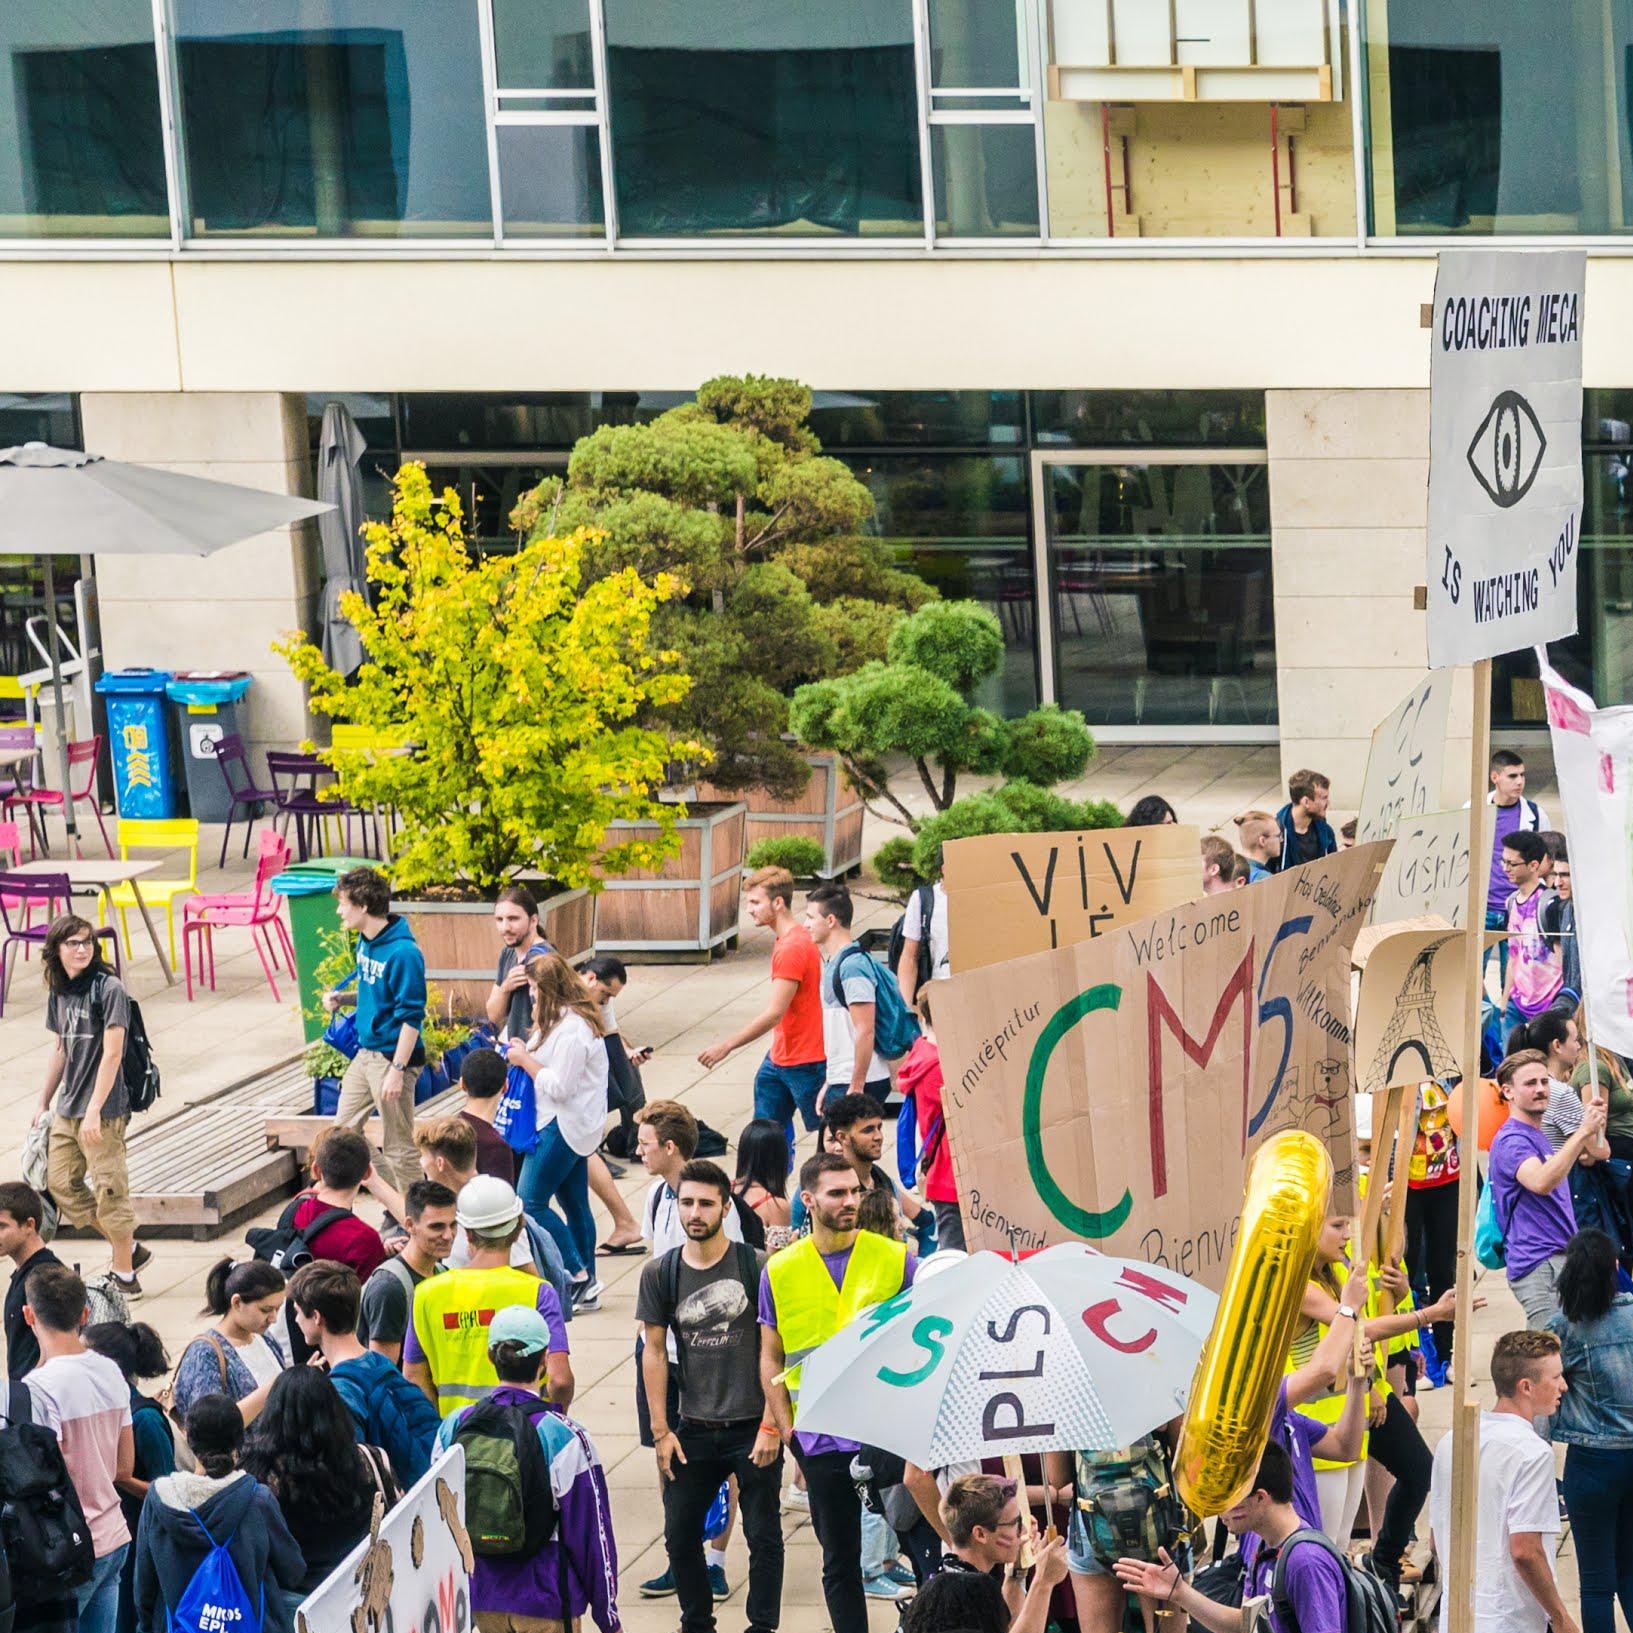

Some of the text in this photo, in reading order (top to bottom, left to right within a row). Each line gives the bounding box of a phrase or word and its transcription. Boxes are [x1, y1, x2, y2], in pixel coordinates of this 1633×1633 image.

[1443, 292, 1578, 350] COACHING MECA
[1442, 513, 1577, 623] IS WATCHING YOU
[1108, 909, 1242, 966] Welcome
[1022, 914, 1313, 1240] CMS
[980, 1303, 1056, 1445] PLS
